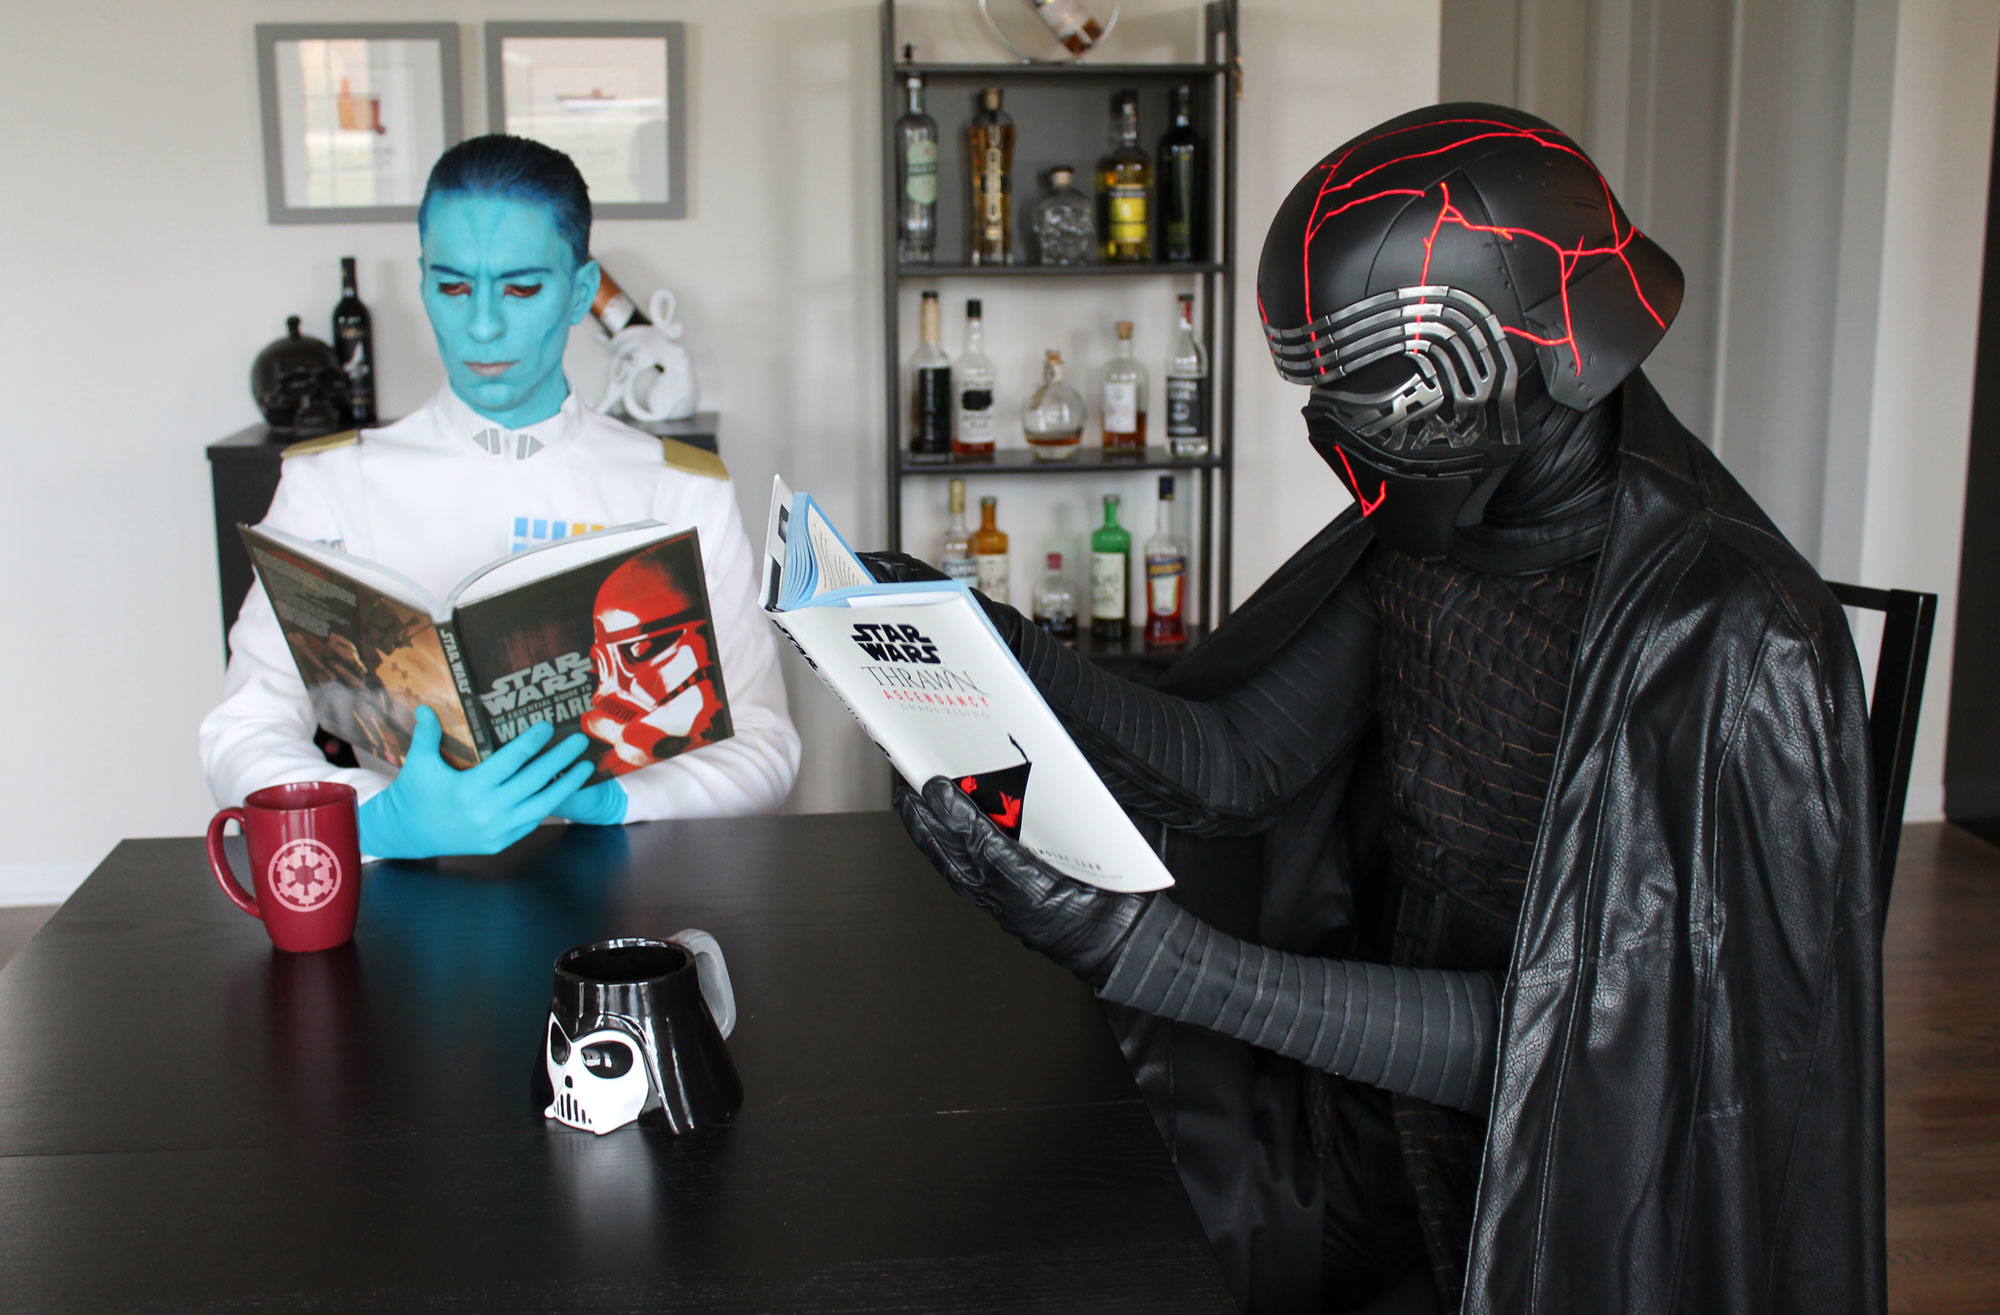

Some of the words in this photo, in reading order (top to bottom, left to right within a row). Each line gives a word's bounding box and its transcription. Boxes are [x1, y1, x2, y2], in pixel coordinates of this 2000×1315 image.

[851, 623, 933, 644] STAR
[440, 629, 460, 666] STAR
[450, 664, 473, 695] WARS
[857, 643, 941, 664] WARS
[480, 651, 592, 700] STAR
[480, 664, 593, 717] WARS
[861, 666, 991, 696] THRAWN
[508, 698, 552, 720] ESSENTIAL
[554, 688, 579, 702] GUIDE
[581, 684, 592, 693] TO
[883, 688, 989, 708] ASCENDANCY
[493, 692, 596, 744] WARFARE
